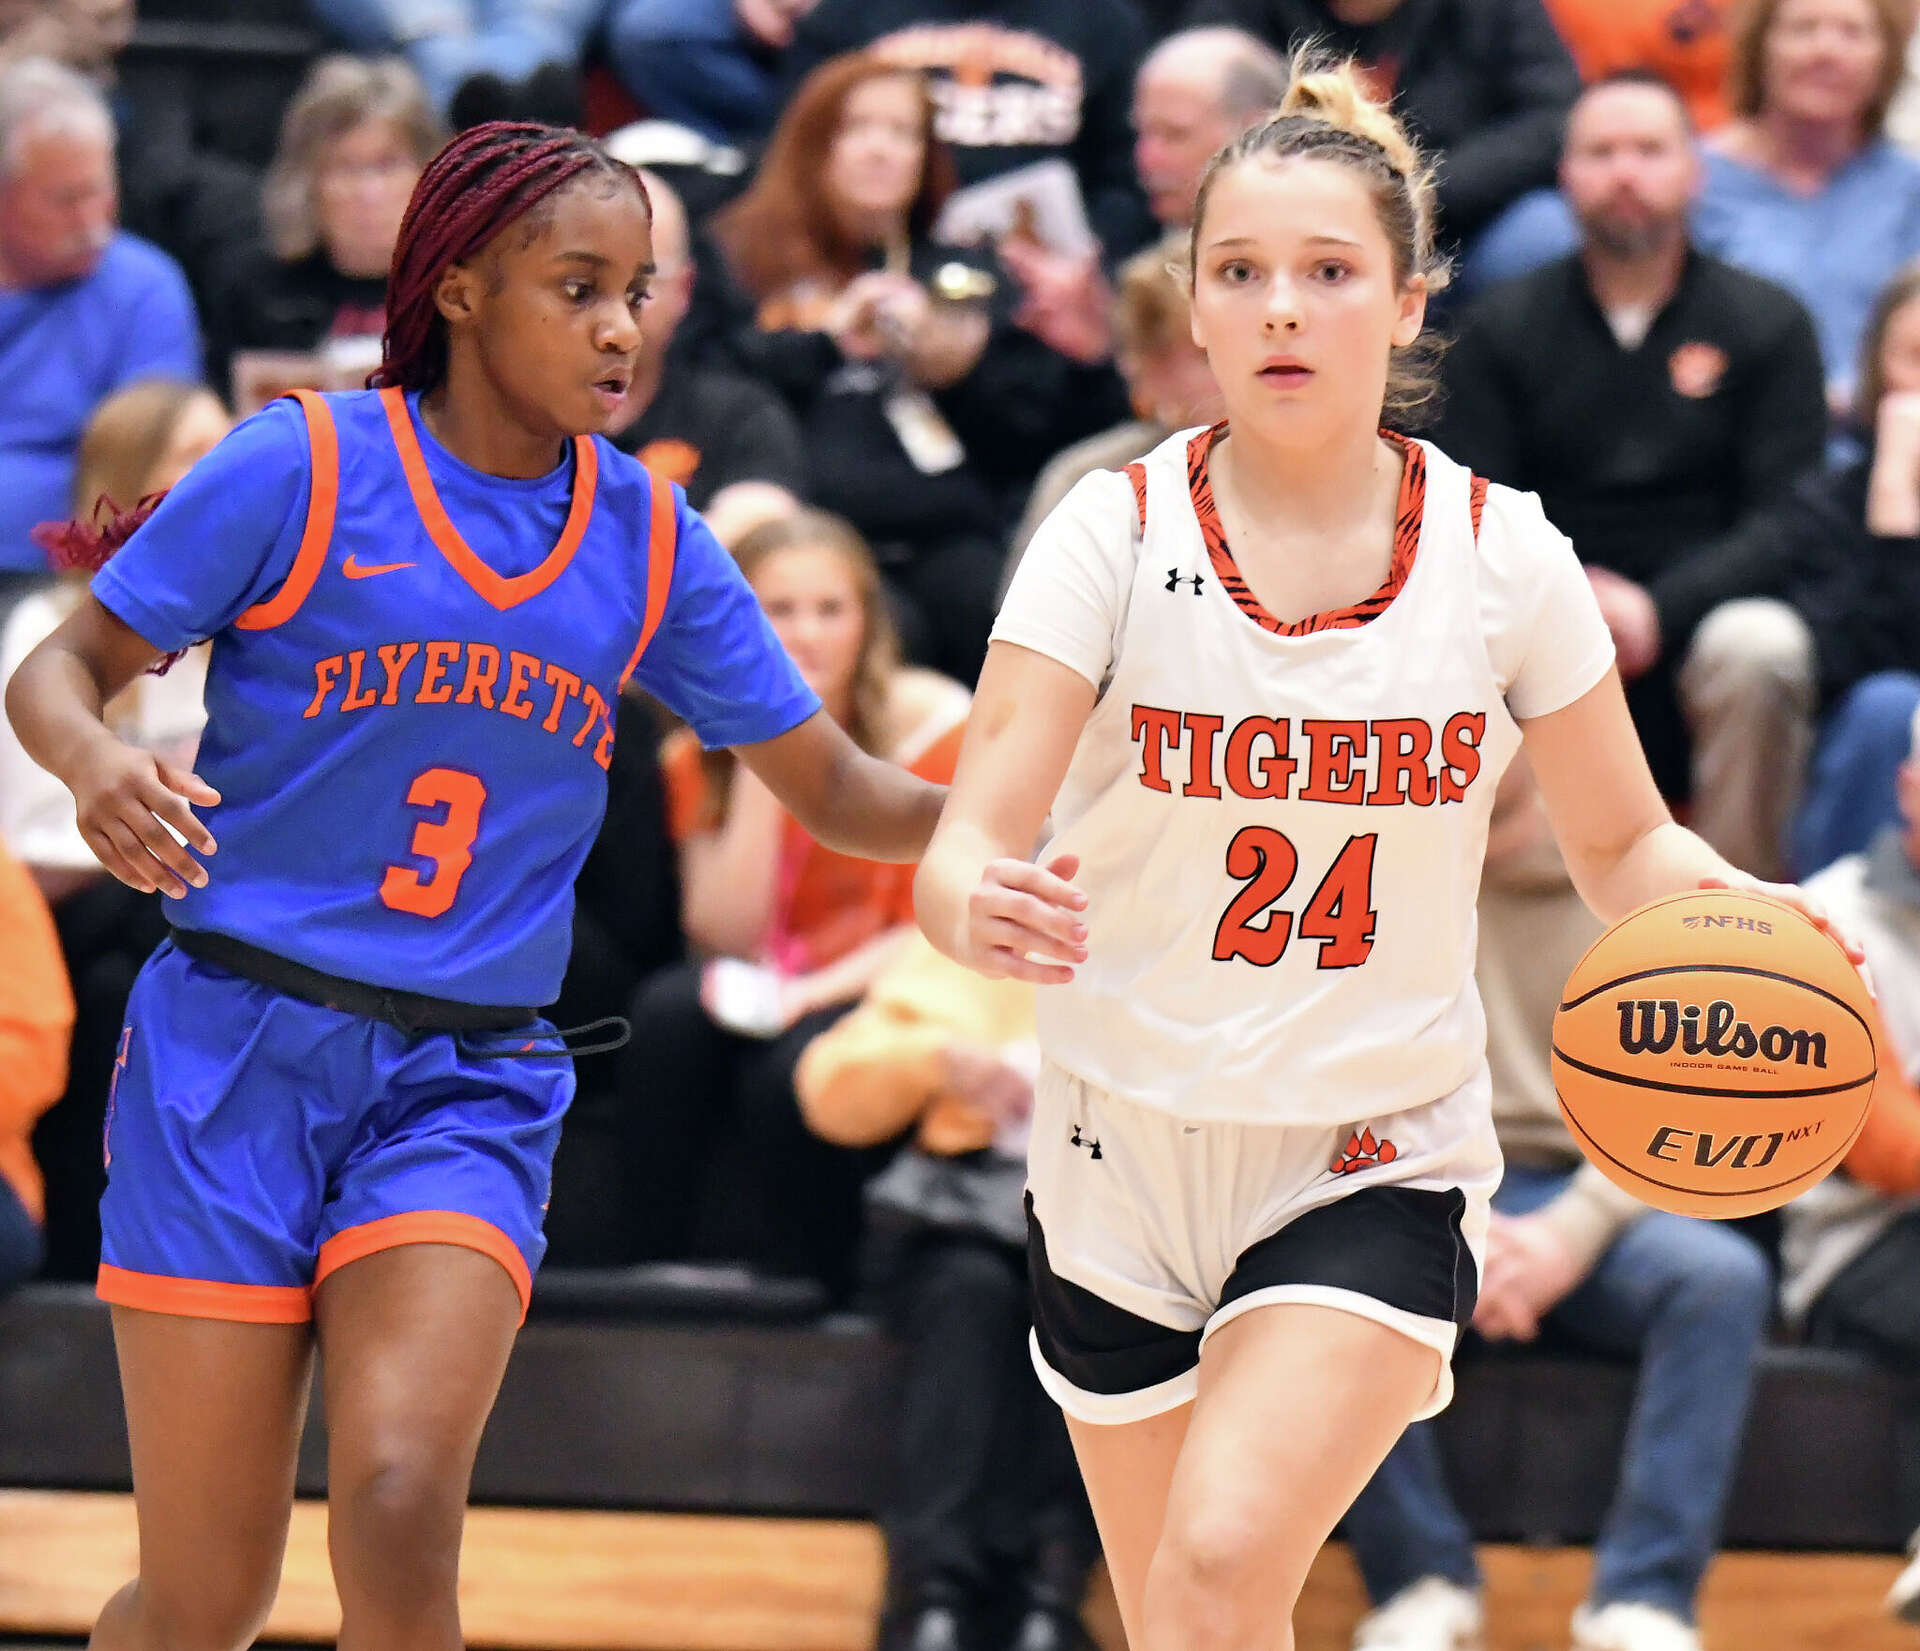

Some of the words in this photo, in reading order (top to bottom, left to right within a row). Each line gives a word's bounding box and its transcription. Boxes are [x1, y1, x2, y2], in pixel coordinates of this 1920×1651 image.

[1131, 703, 1486, 806] TIGERS
[378, 767, 488, 918] 3
[1211, 825, 1379, 970] 24
[1703, 915, 1773, 935] NFHS
[1616, 998, 1828, 1069] Wilson
[1717, 1064, 1748, 1072] GAME
[1753, 1067, 1778, 1075] BALL
[1646, 1126, 1784, 1168] EVO
[1786, 1119, 1825, 1142] NXT
